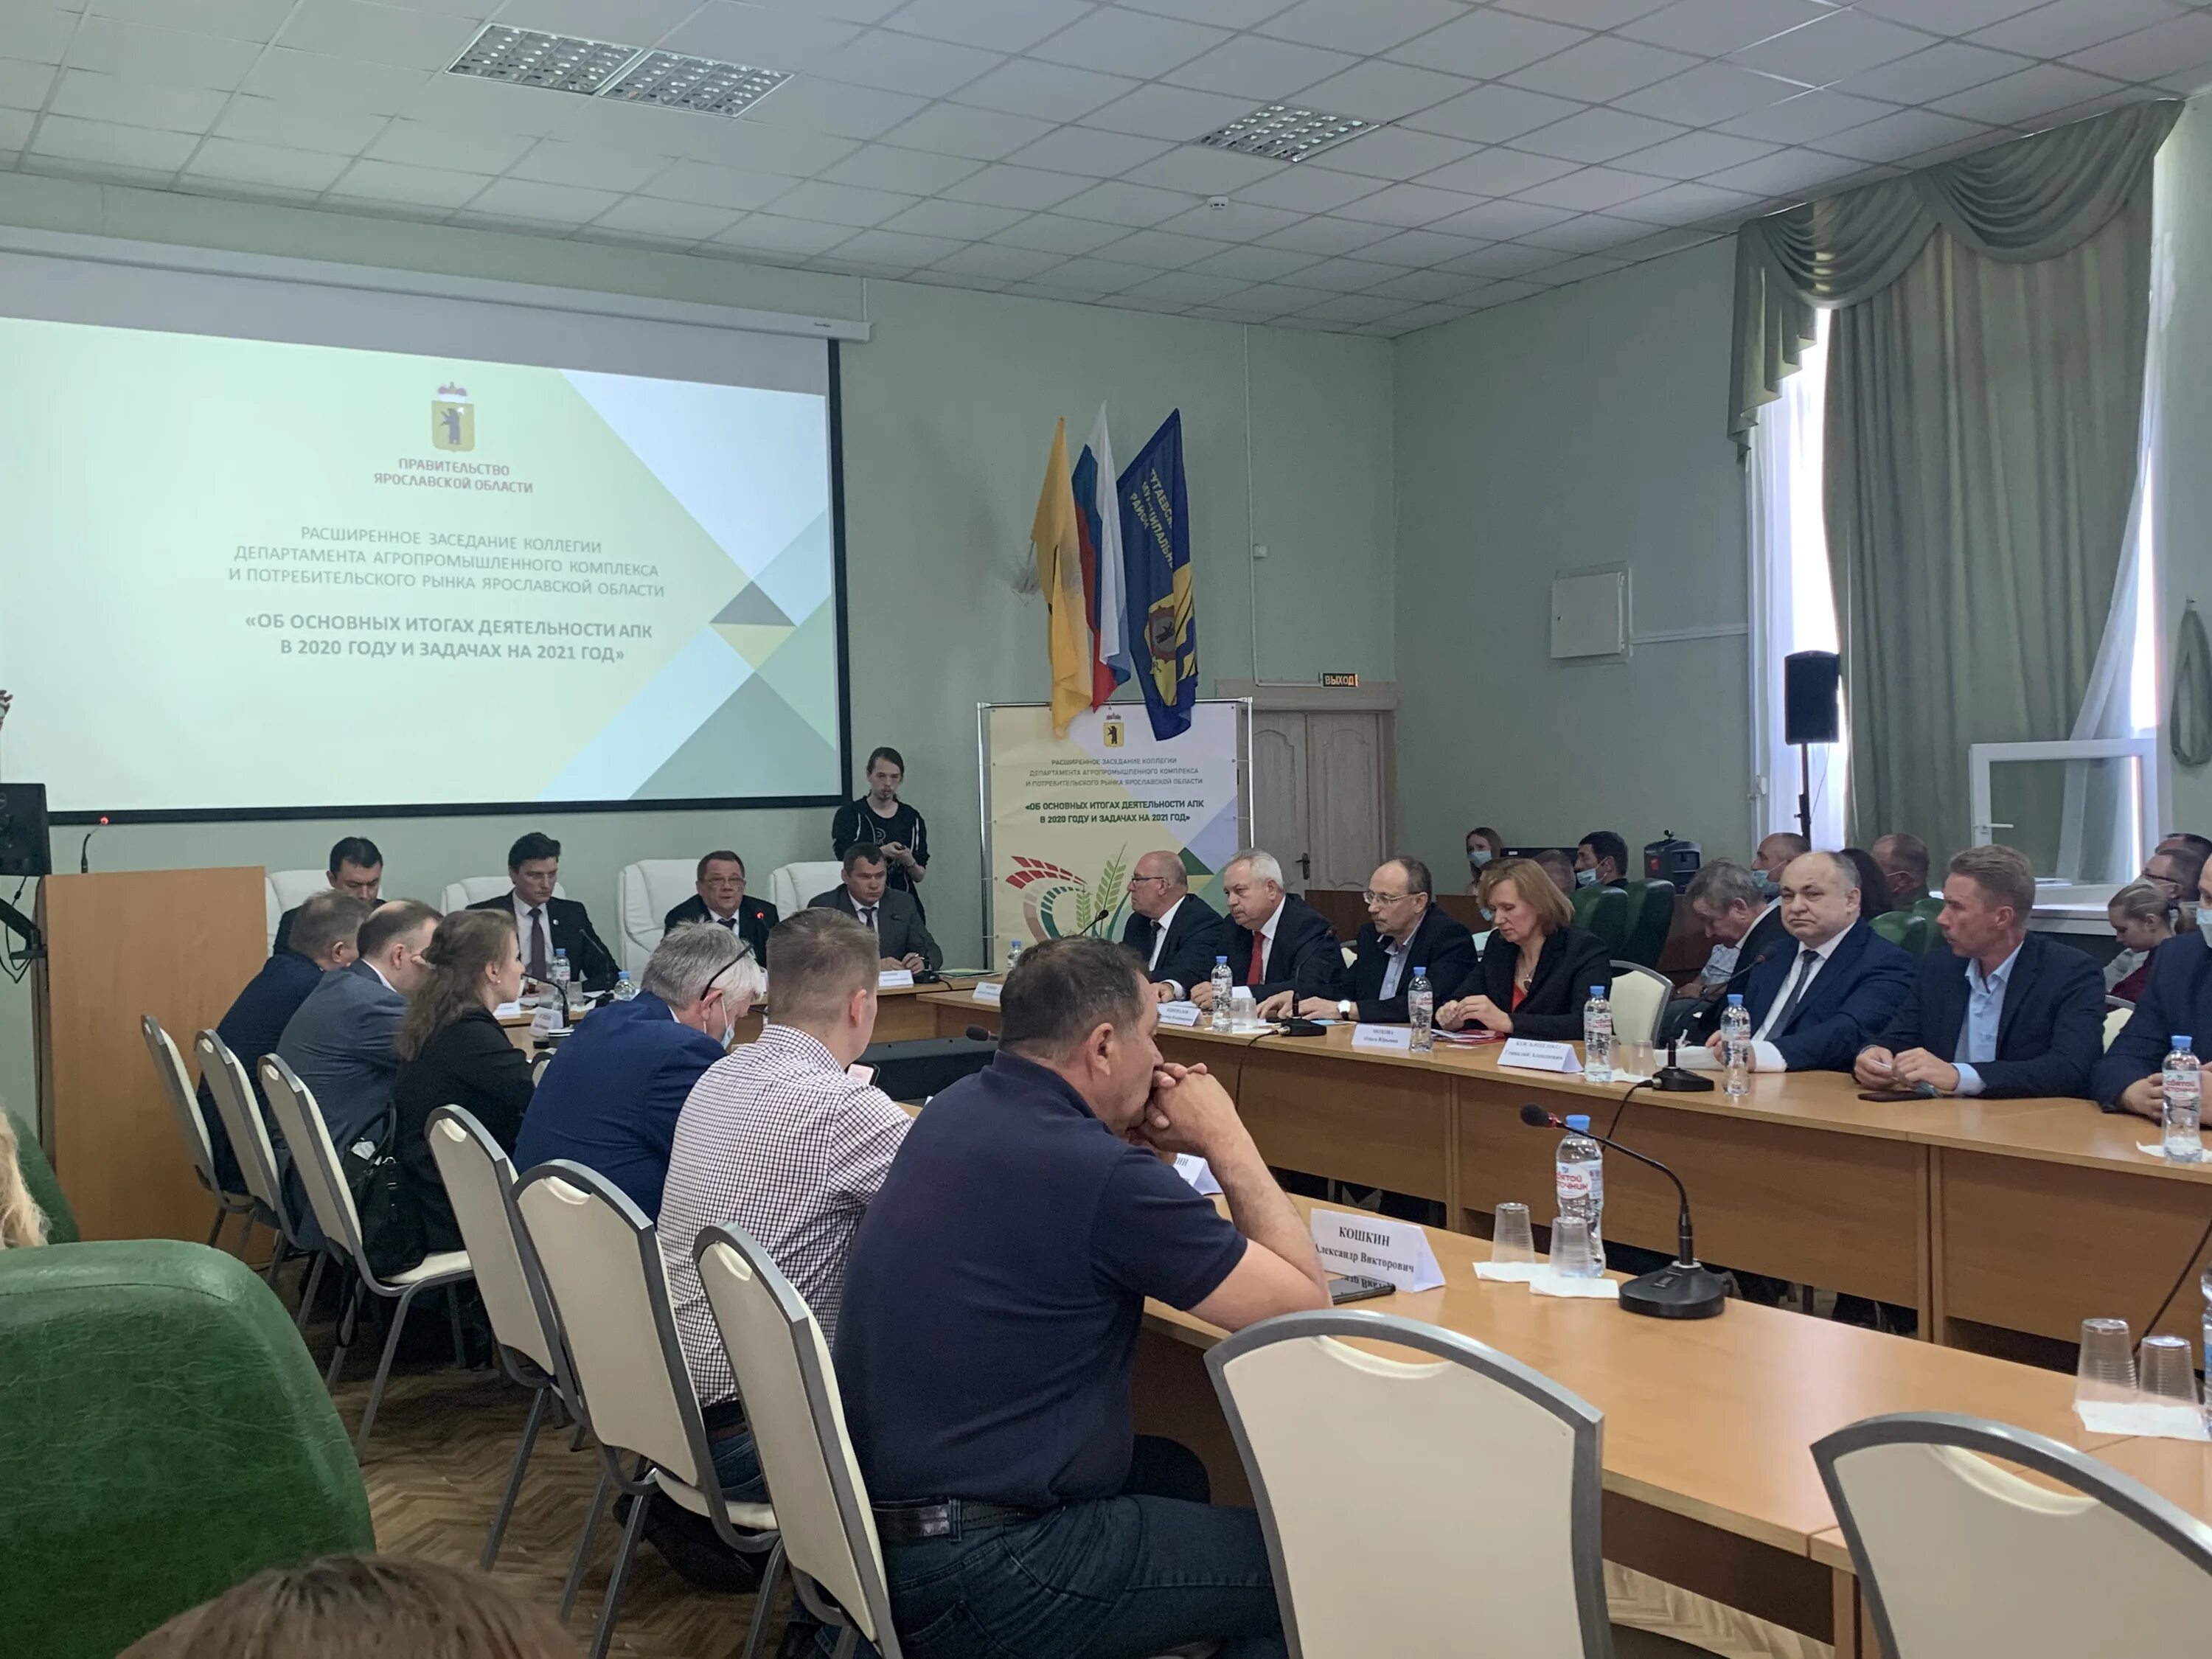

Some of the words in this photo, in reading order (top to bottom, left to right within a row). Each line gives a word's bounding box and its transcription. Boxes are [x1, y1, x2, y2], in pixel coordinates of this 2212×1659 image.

[398, 458, 509, 476] ПРАВИТЕЛЬСТВО
[373, 473, 470, 488] ЯРОСЛАВСКОЙ
[474, 479, 532, 493] ОБЛАСТИ
[1150, 468, 1173, 529] ТУТАЕВСК
[301, 526, 420, 544] РАСШИРЕННОЕ
[428, 532, 517, 549] ЗАСЕДАНИЕ
[524, 538, 601, 552] КОЛЛЕГИИ
[233, 546, 366, 562] ДЕПАРТАМЕНТА
[372, 552, 562, 571] АГРОПРОМЫШЛЕННОГО
[569, 561, 658, 576] КОМПЛЕКСА
[229, 568, 240, 580] И
[246, 568, 416, 586] ПОТРЕБИТЕЛЬСКОГО
[422, 574, 476, 588] РЫНКА
[481, 577, 591, 593] ЯРОСЛАВСКОЙ
[597, 582, 664, 596] ОБЛАСТИ
[245, 613, 284, 627] «ОБ
[290, 614, 400, 630] ОСНОВНЫХ
[406, 617, 474, 632] ИТОГАХ
[477, 619, 615, 636] ДЕЯТЕЛЬНОСТИ
[619, 625, 652, 638] АПК
[280, 639, 292, 653] В
[297, 639, 341, 654] 2020
[348, 640, 397, 658] ГОДУ
[401, 641, 414, 655] И
[420, 642, 501, 659] ЗАДАЧАХ
[507, 644, 532, 658] НА
[537, 645, 575, 659] 2021
[581, 646, 624, 663] ГОД»
[1325, 675, 1354, 686] ВЫХОД
[1124, 777, 1172, 785] ЯРОСЛАВСКОЙ
[1042, 801, 1088, 810] ОСНОВНЫХ
[1089, 801, 1120, 809] ИТОГАХ
[1121, 800, 1185, 809] ДЕЯТЕЛЬНОСТИ
[1186, 799, 1204, 807] АПК
[1047, 815, 1065, 823] 2020
[1068, 815, 1089, 824] ГОДУ
[1099, 814, 1136, 823] ЗАДАЧАХ
[1138, 813, 1150, 821] НА
[1151, 813, 1168, 821] 2021
[1169, 813, 1190, 821] ГОД»
[1339, 1226, 1391, 1247] КОШКИН
[1360, 1252, 1414, 1273] Викторович
